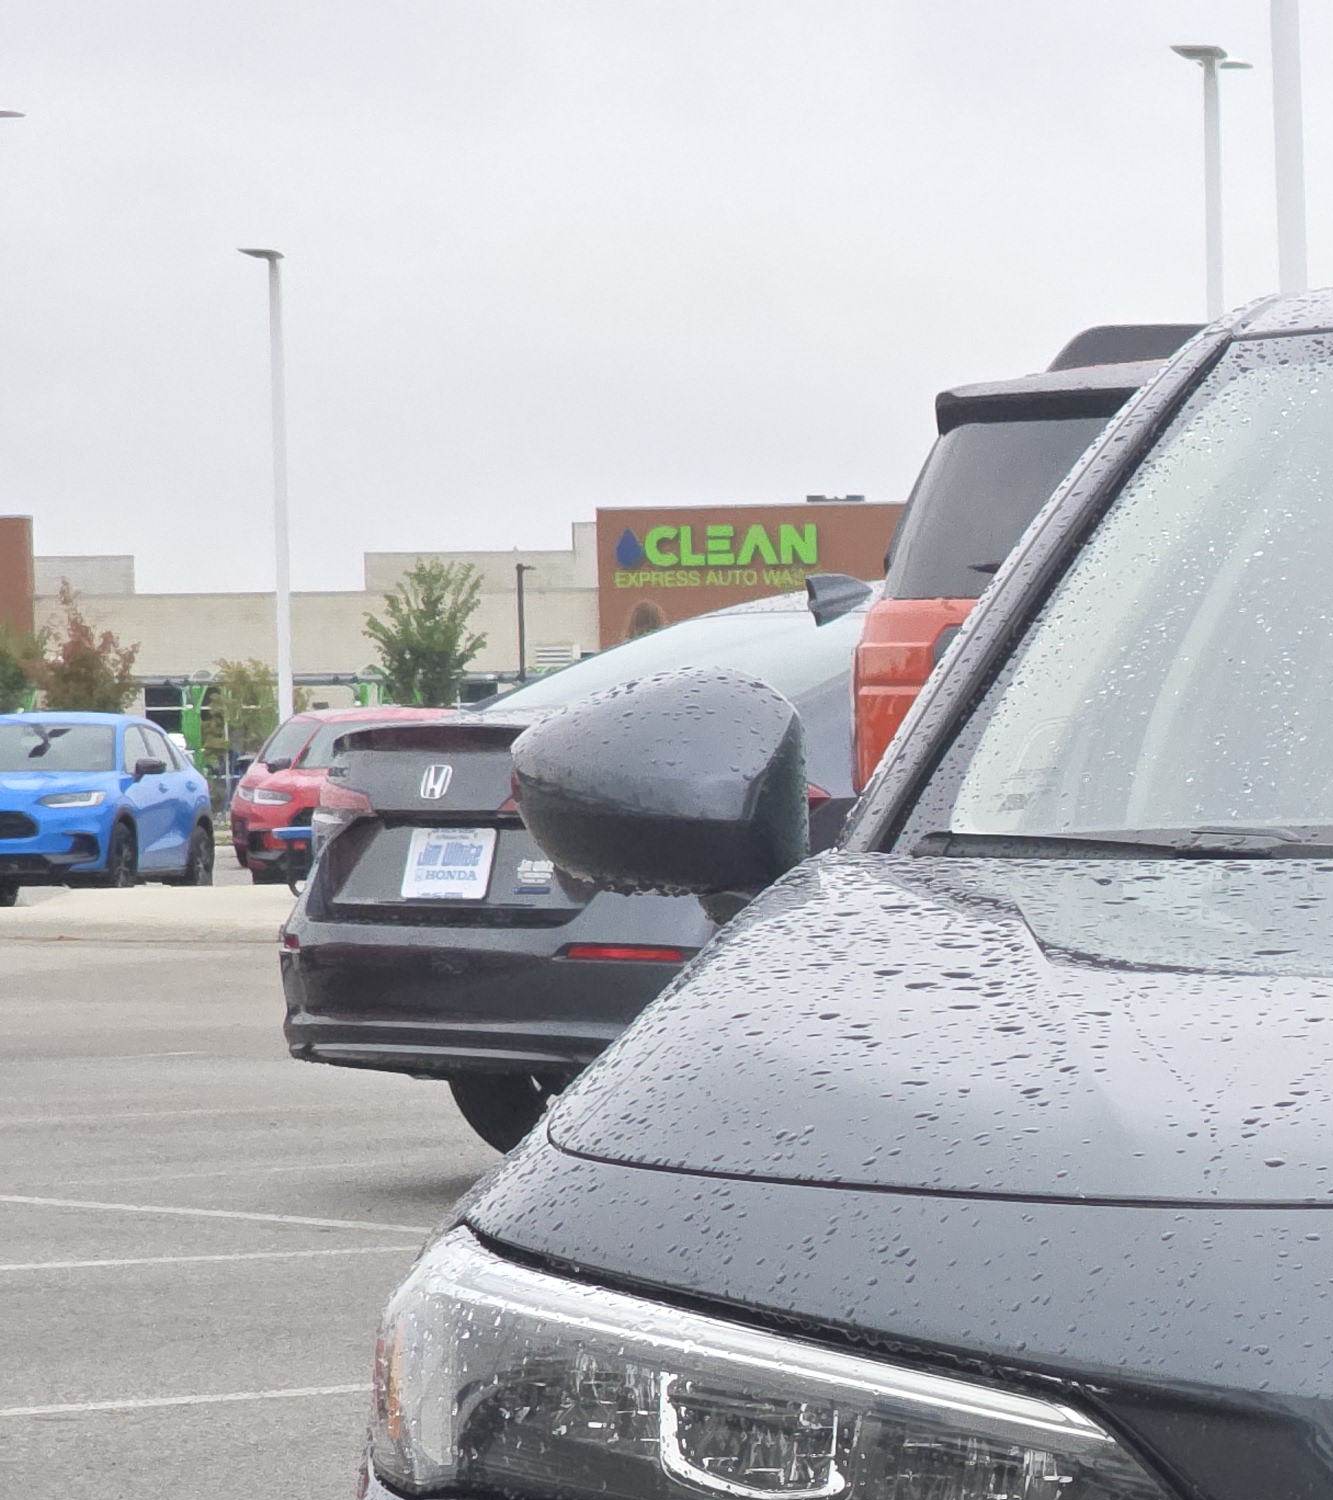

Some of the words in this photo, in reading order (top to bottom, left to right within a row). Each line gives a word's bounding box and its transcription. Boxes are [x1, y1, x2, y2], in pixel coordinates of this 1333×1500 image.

[644, 524, 817, 567] CLEAN
[614, 570, 701, 588] EXPRESS
[706, 569, 758, 586] AUTO
[425, 870, 478, 880] HONDA
